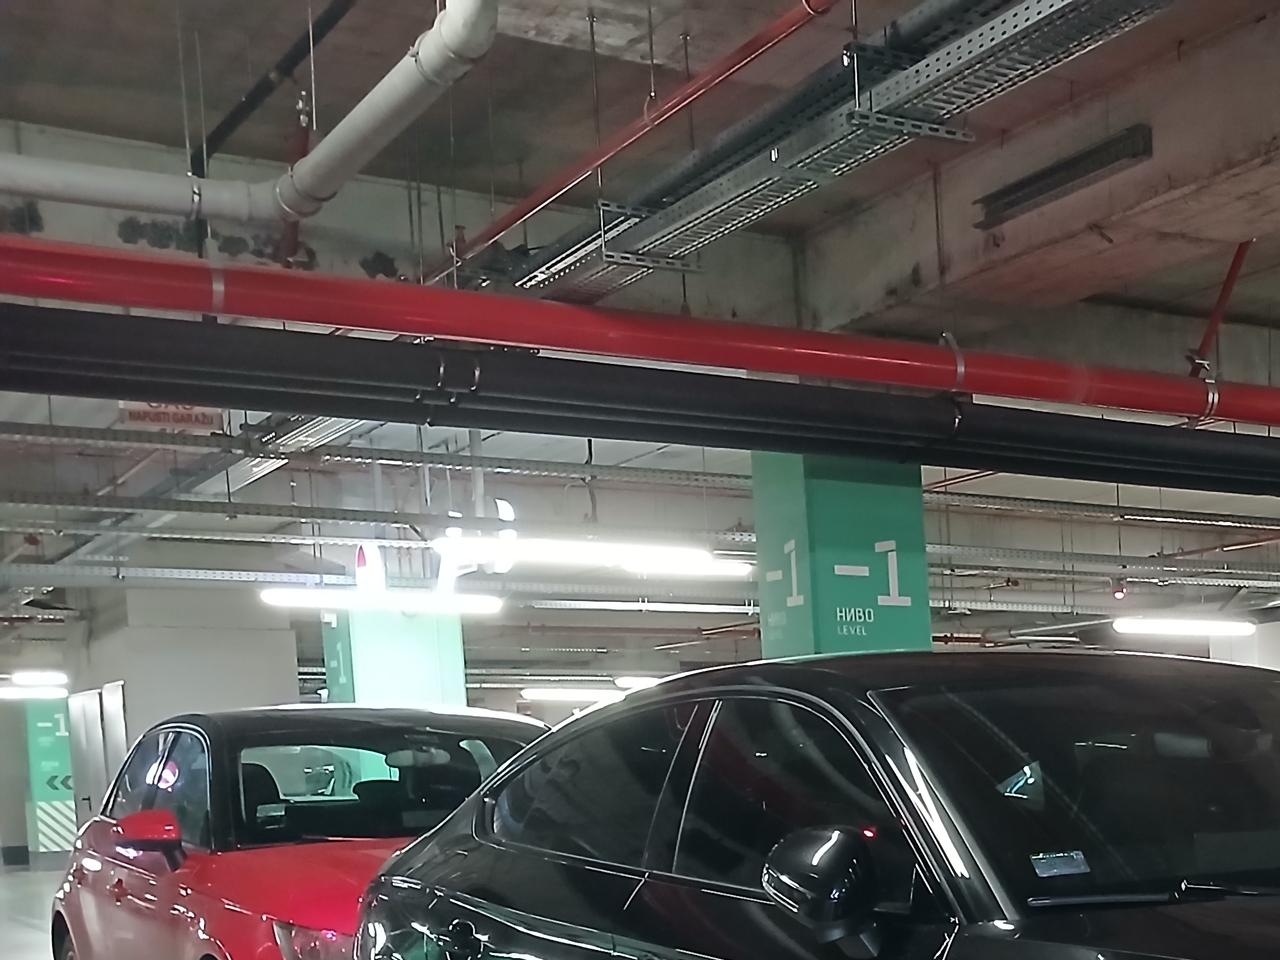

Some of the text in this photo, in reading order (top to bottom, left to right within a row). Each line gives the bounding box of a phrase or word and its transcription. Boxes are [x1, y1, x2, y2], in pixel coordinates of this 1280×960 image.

[766, 539, 804, 607] -1
[834, 540, 911, 606] -1
[836, 607, 874, 622] НИВО
[837, 625, 867, 635] LEVEL
